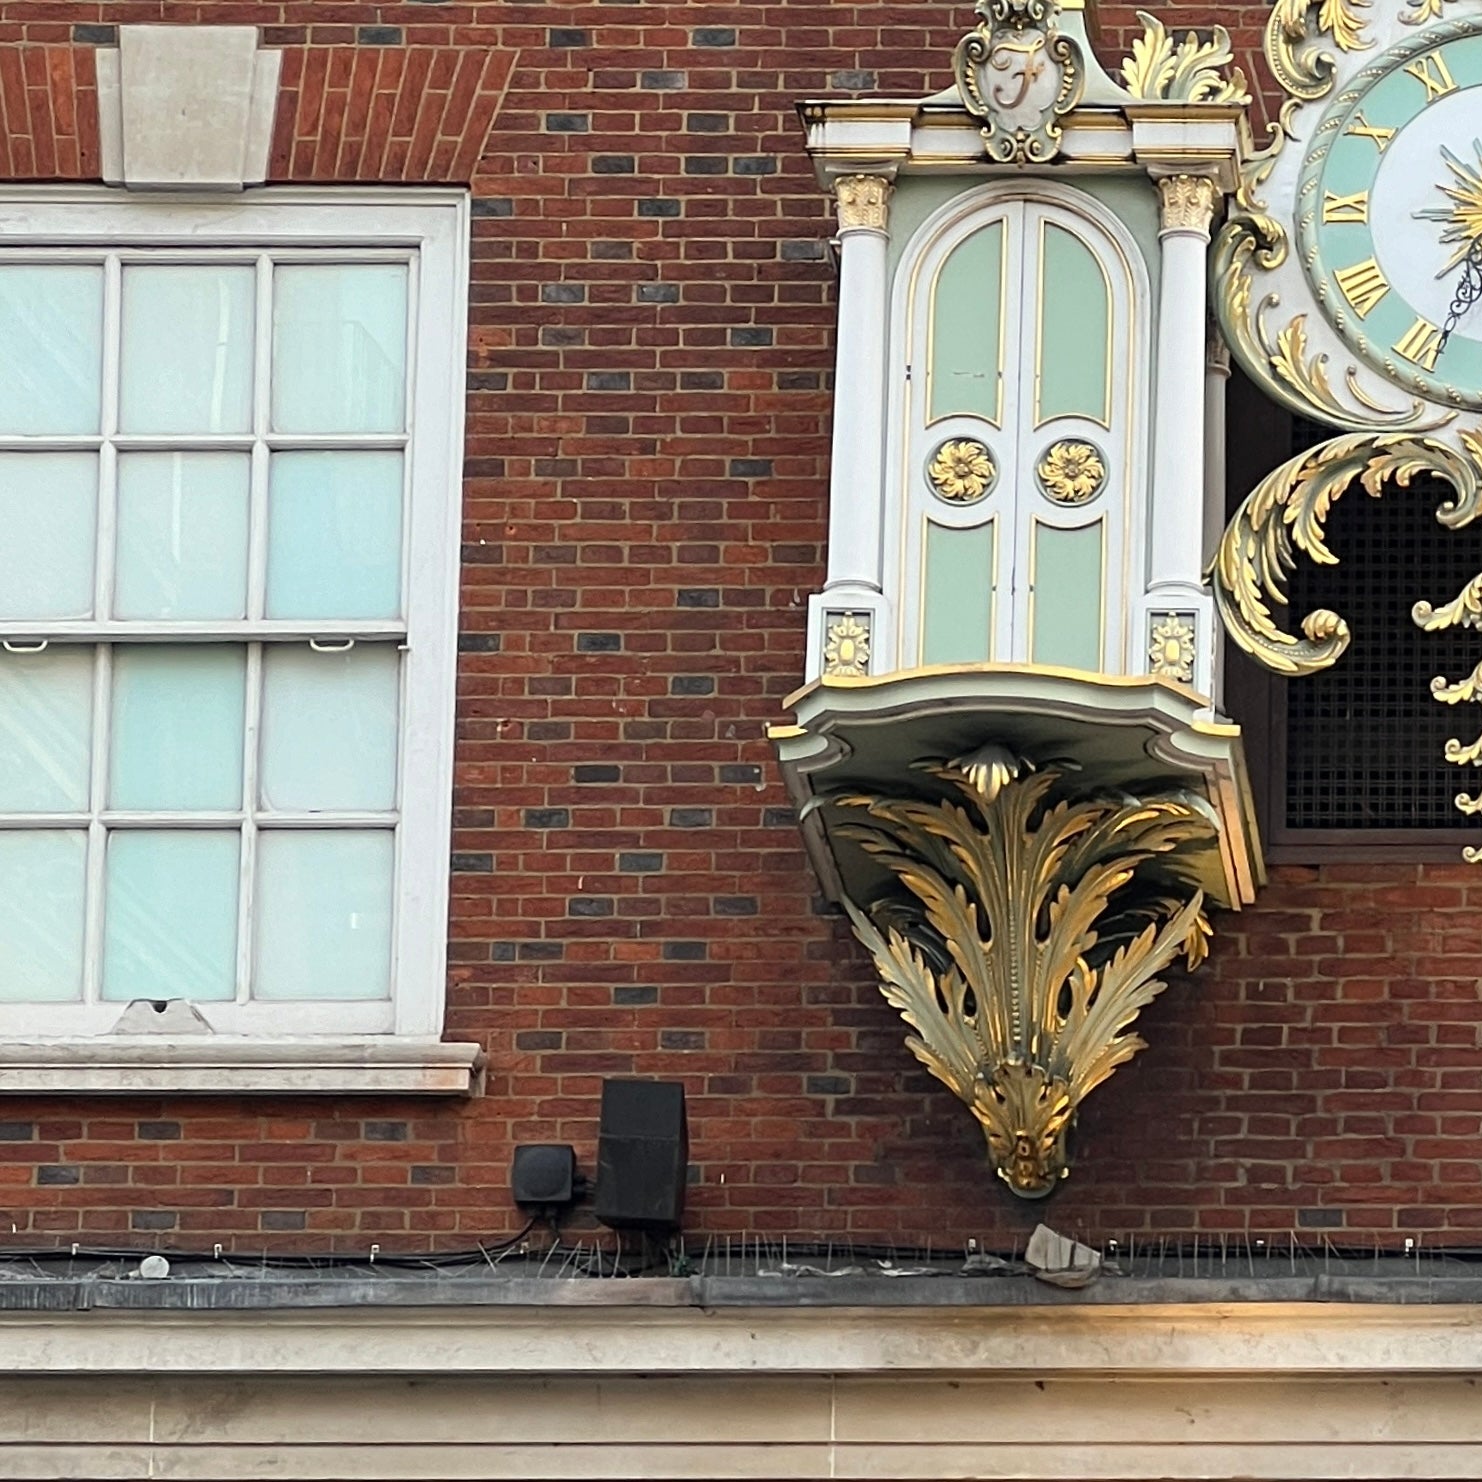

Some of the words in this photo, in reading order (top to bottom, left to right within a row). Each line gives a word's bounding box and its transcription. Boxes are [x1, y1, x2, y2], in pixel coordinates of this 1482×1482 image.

[1403, 50, 1460, 104] XI
[1343, 109, 1399, 154] X
[1323, 190, 1368, 225] IX
[1333, 255, 1391, 321] VIII
